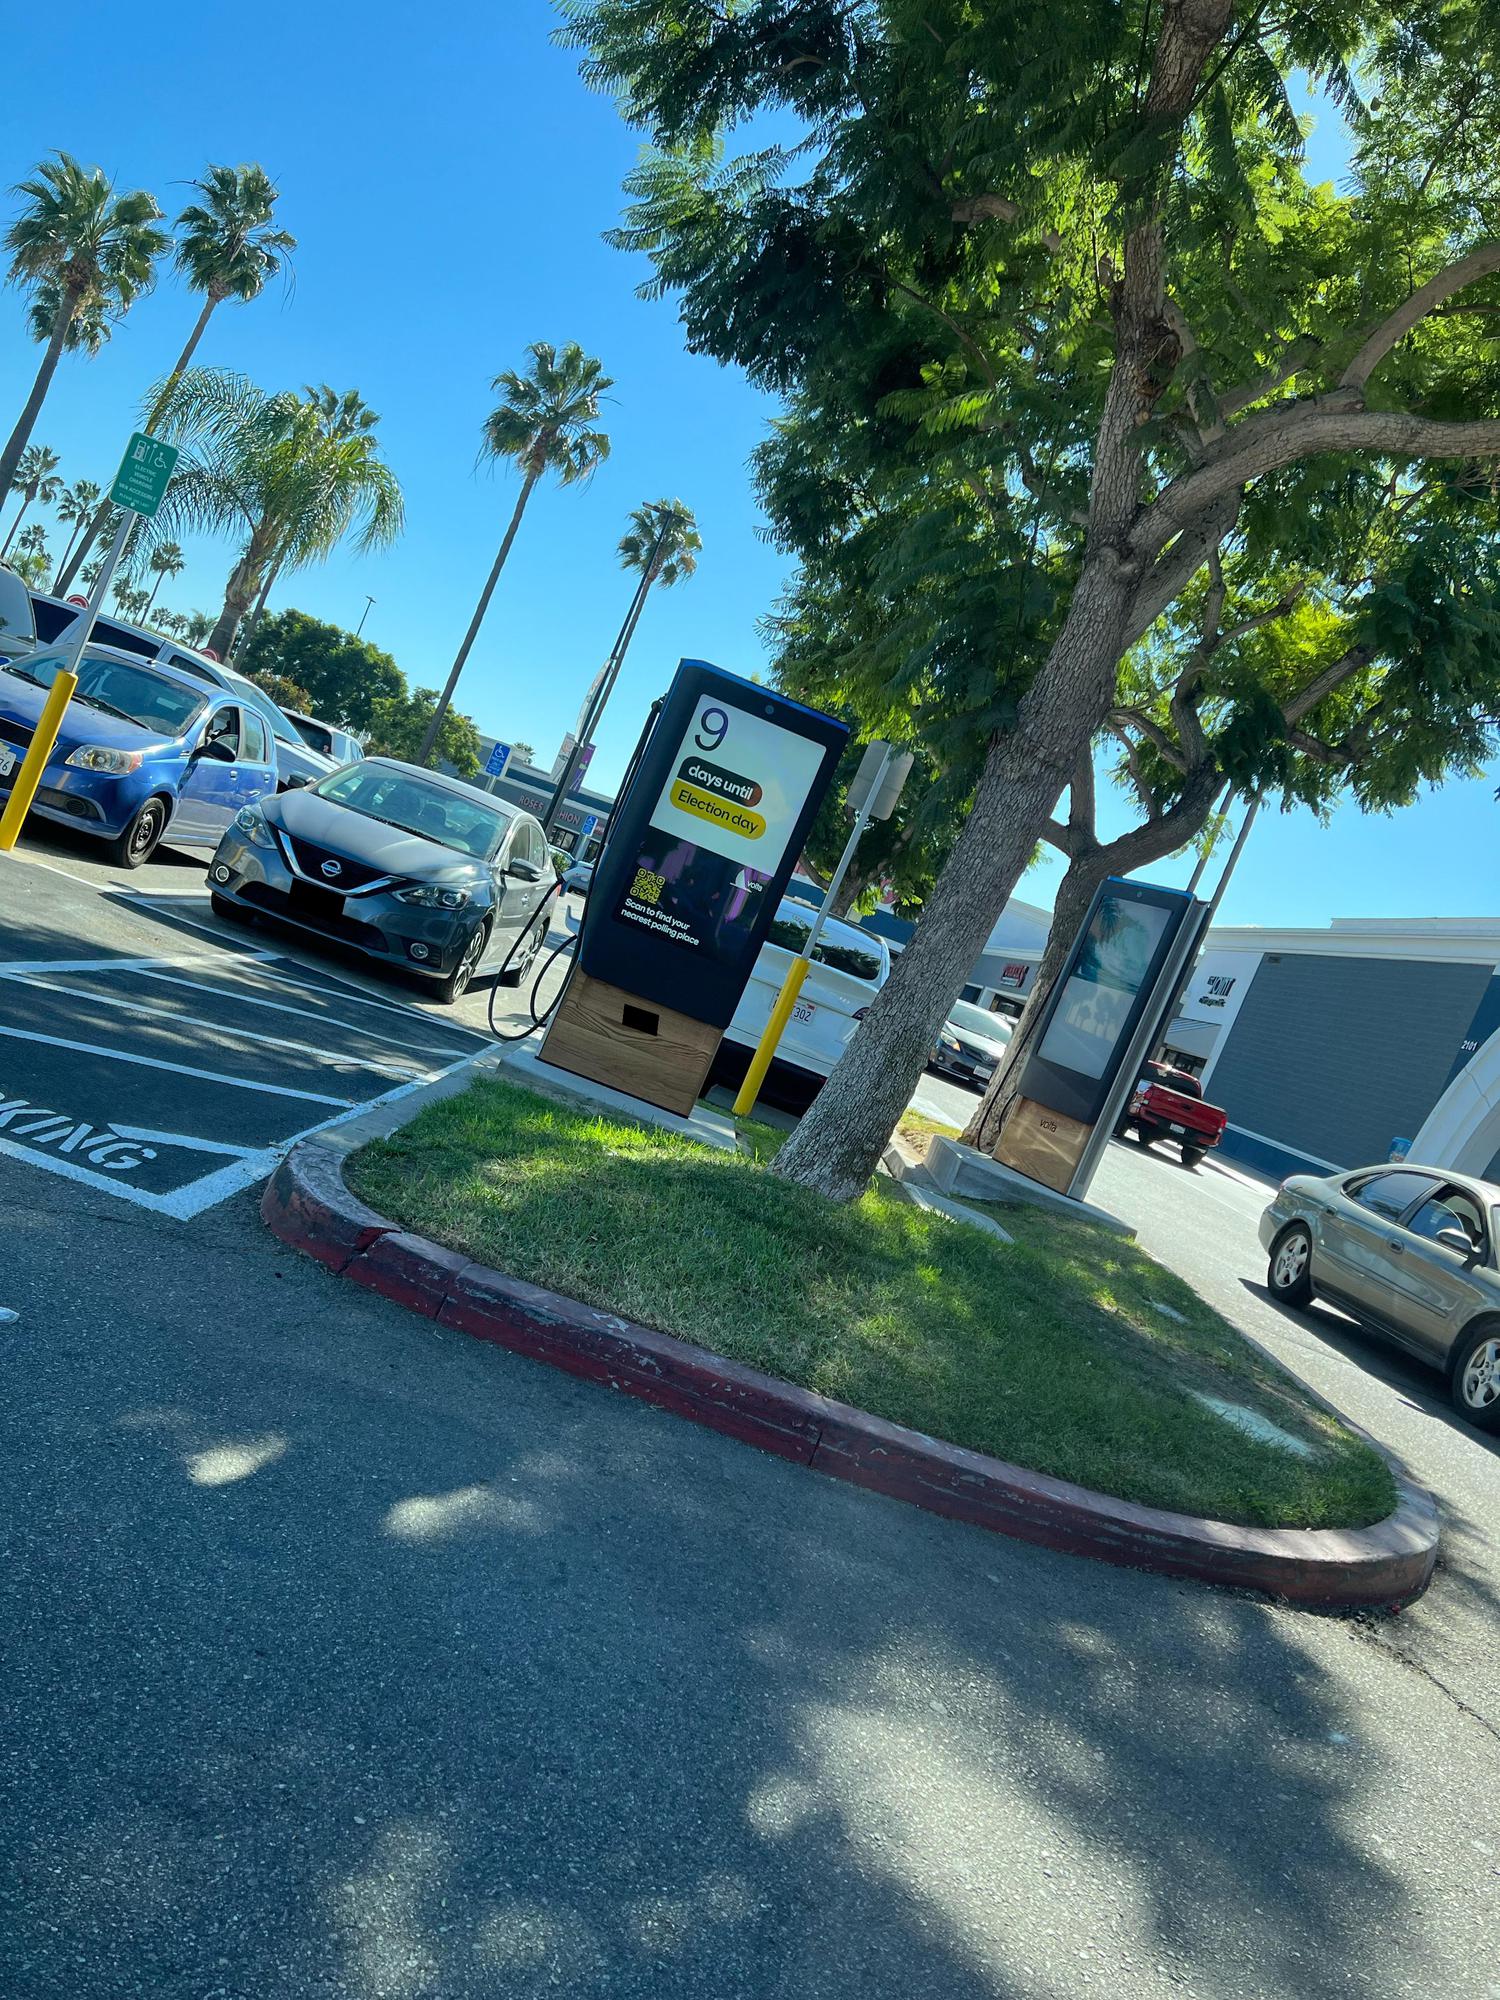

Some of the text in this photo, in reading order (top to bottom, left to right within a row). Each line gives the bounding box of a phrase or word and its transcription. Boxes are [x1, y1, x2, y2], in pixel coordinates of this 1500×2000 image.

[695, 708, 729, 751] 9
[688, 765, 754, 801] days until
[678, 789, 759, 834] Election day
[621, 909, 699, 945] nearest polling place
[625, 897, 690, 930] Scan to find your
